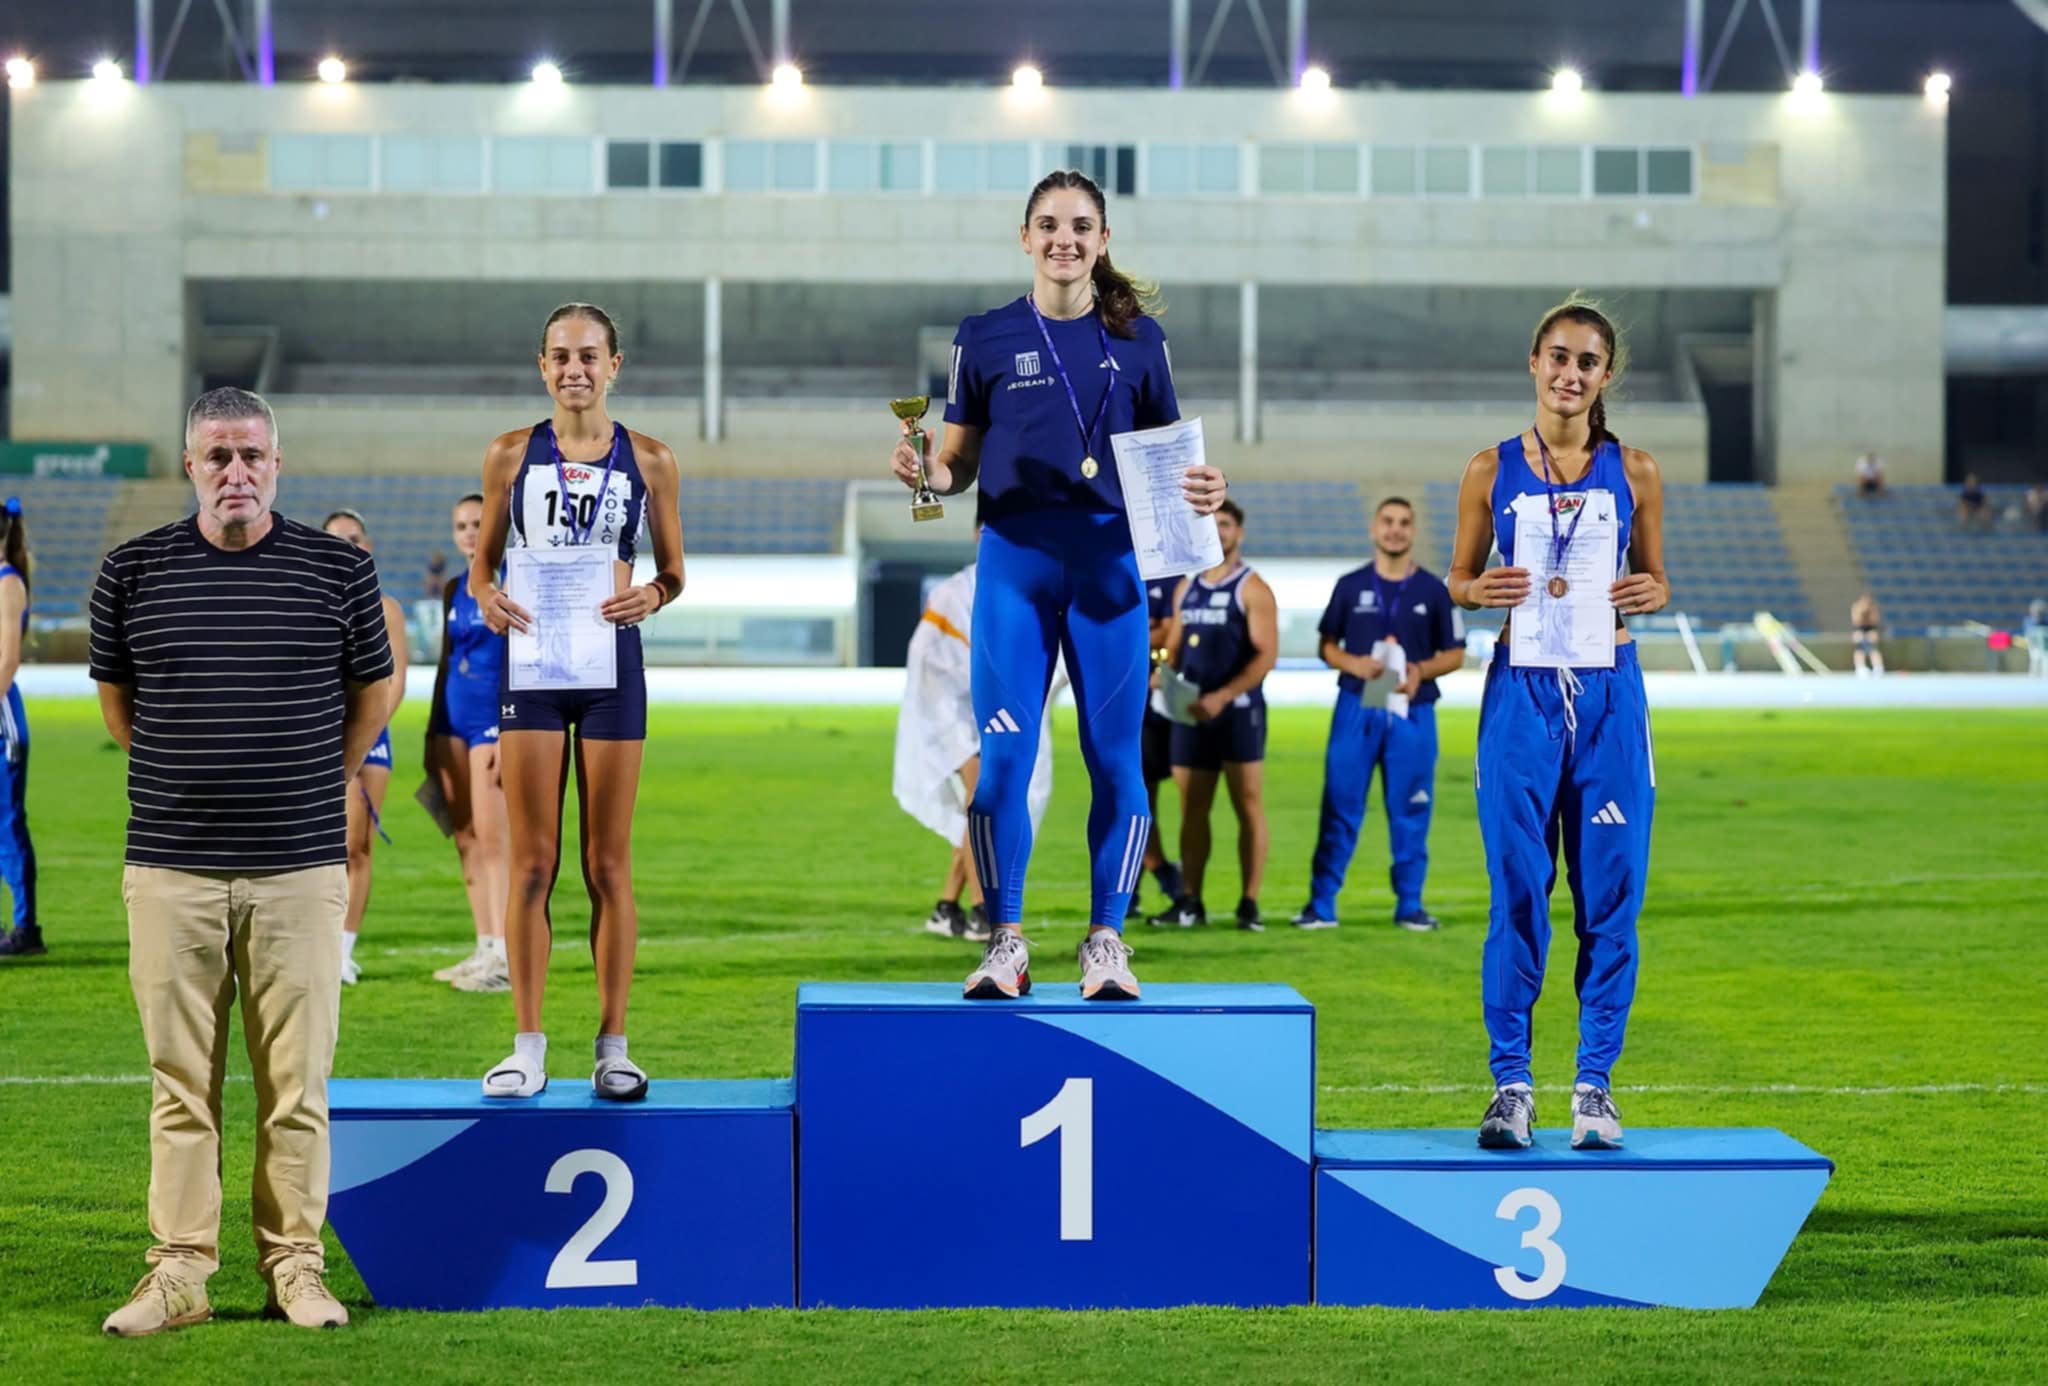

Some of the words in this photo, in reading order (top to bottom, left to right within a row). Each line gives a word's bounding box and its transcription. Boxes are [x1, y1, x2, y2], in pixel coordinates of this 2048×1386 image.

[545, 490, 598, 528] 150
[561, 466, 591, 481] KEAN
[1020, 1078, 1093, 1240] 1
[544, 1149, 638, 1288] 2
[1493, 1187, 1566, 1300] 3
